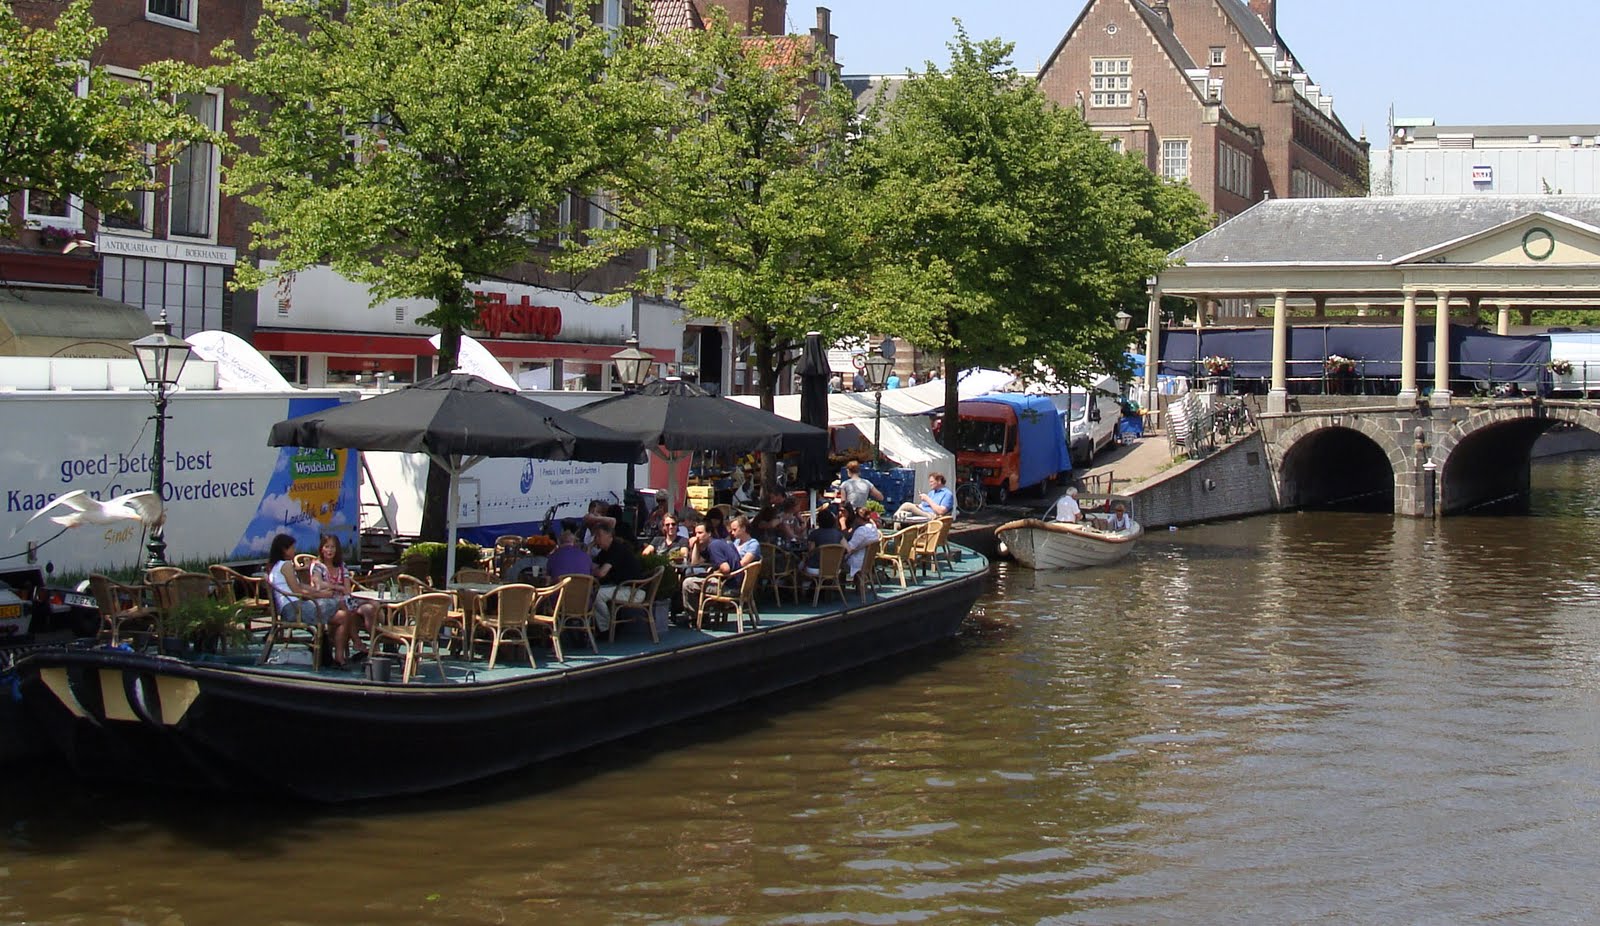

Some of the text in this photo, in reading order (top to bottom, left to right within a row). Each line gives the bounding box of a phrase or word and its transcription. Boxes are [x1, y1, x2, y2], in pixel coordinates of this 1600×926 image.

[185, 248, 228, 260] BOEKHANDEL
[61, 451, 212, 483] goed-bete-best
[295, 461, 336, 474] Weydeland
[7, 490, 57, 512] Kaas
[162, 478, 254, 501] Overdevest
